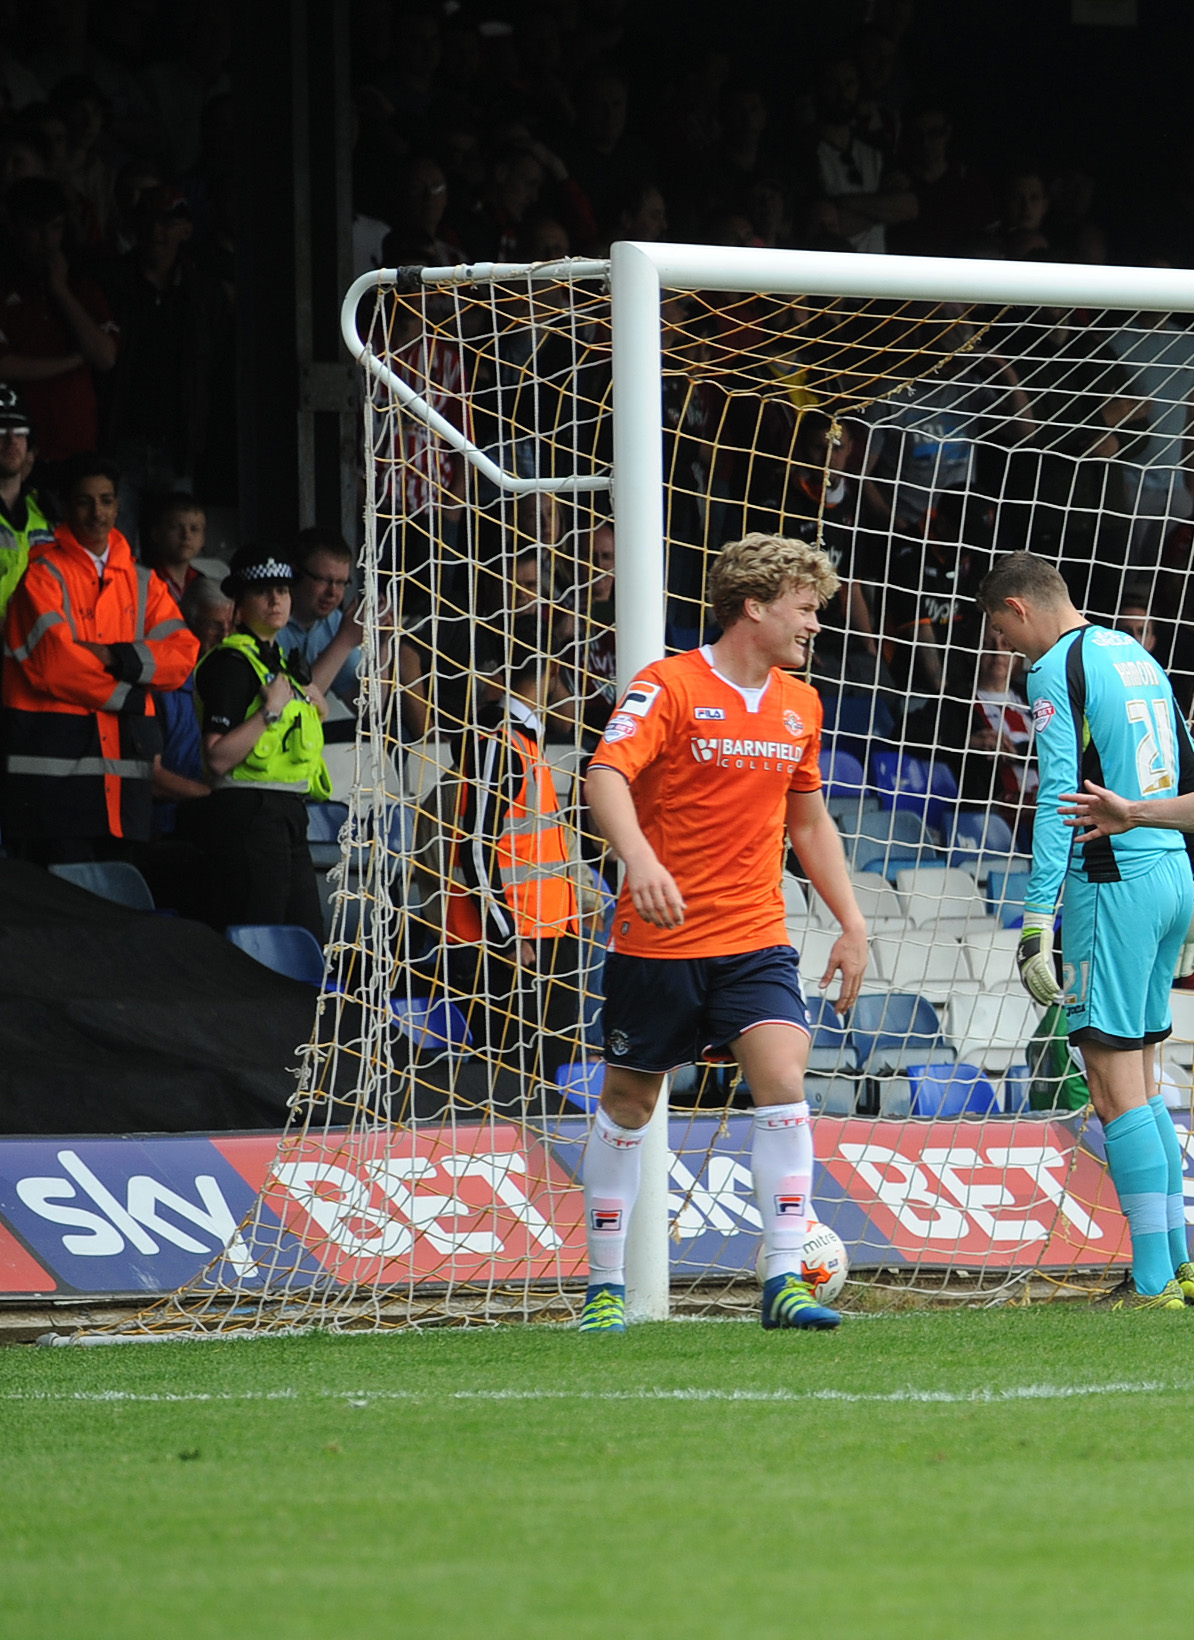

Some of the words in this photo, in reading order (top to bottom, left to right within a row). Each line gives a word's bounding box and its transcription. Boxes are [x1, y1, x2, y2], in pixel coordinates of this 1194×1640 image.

[697, 709, 722, 719] FILA
[722, 738, 802, 763] BARNFIELD
[1126, 698, 1176, 797] 21
[721, 758, 797, 773] COLLEG
[1063, 961, 1091, 1006] 21
[273, 1153, 566, 1258] BET
[838, 1143, 1104, 1241] BET
[802, 1231, 838, 1255] mitre
